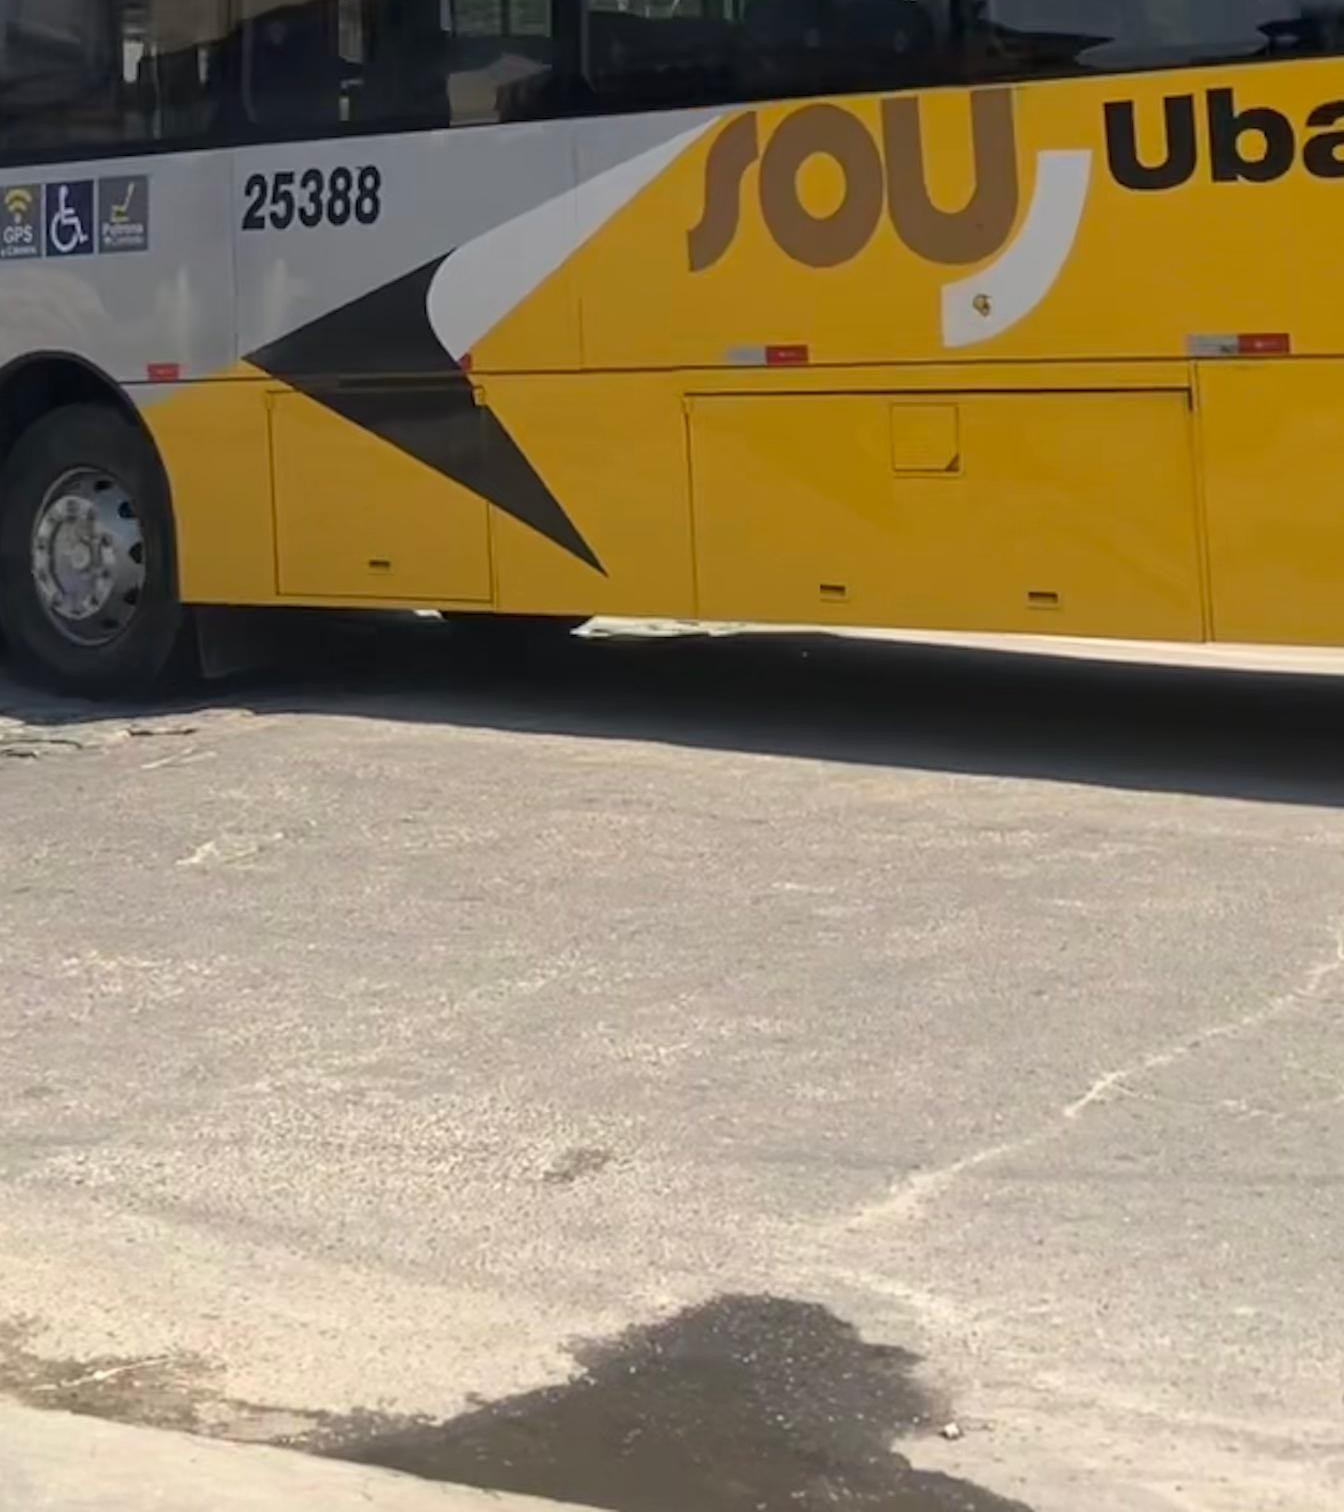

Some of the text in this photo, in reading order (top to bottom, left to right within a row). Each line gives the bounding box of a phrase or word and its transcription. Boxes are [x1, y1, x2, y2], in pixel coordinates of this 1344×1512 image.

[241, 164, 382, 231] 25388
[687, 87, 1019, 272] SOU
[3, 224, 34, 244] GPS
